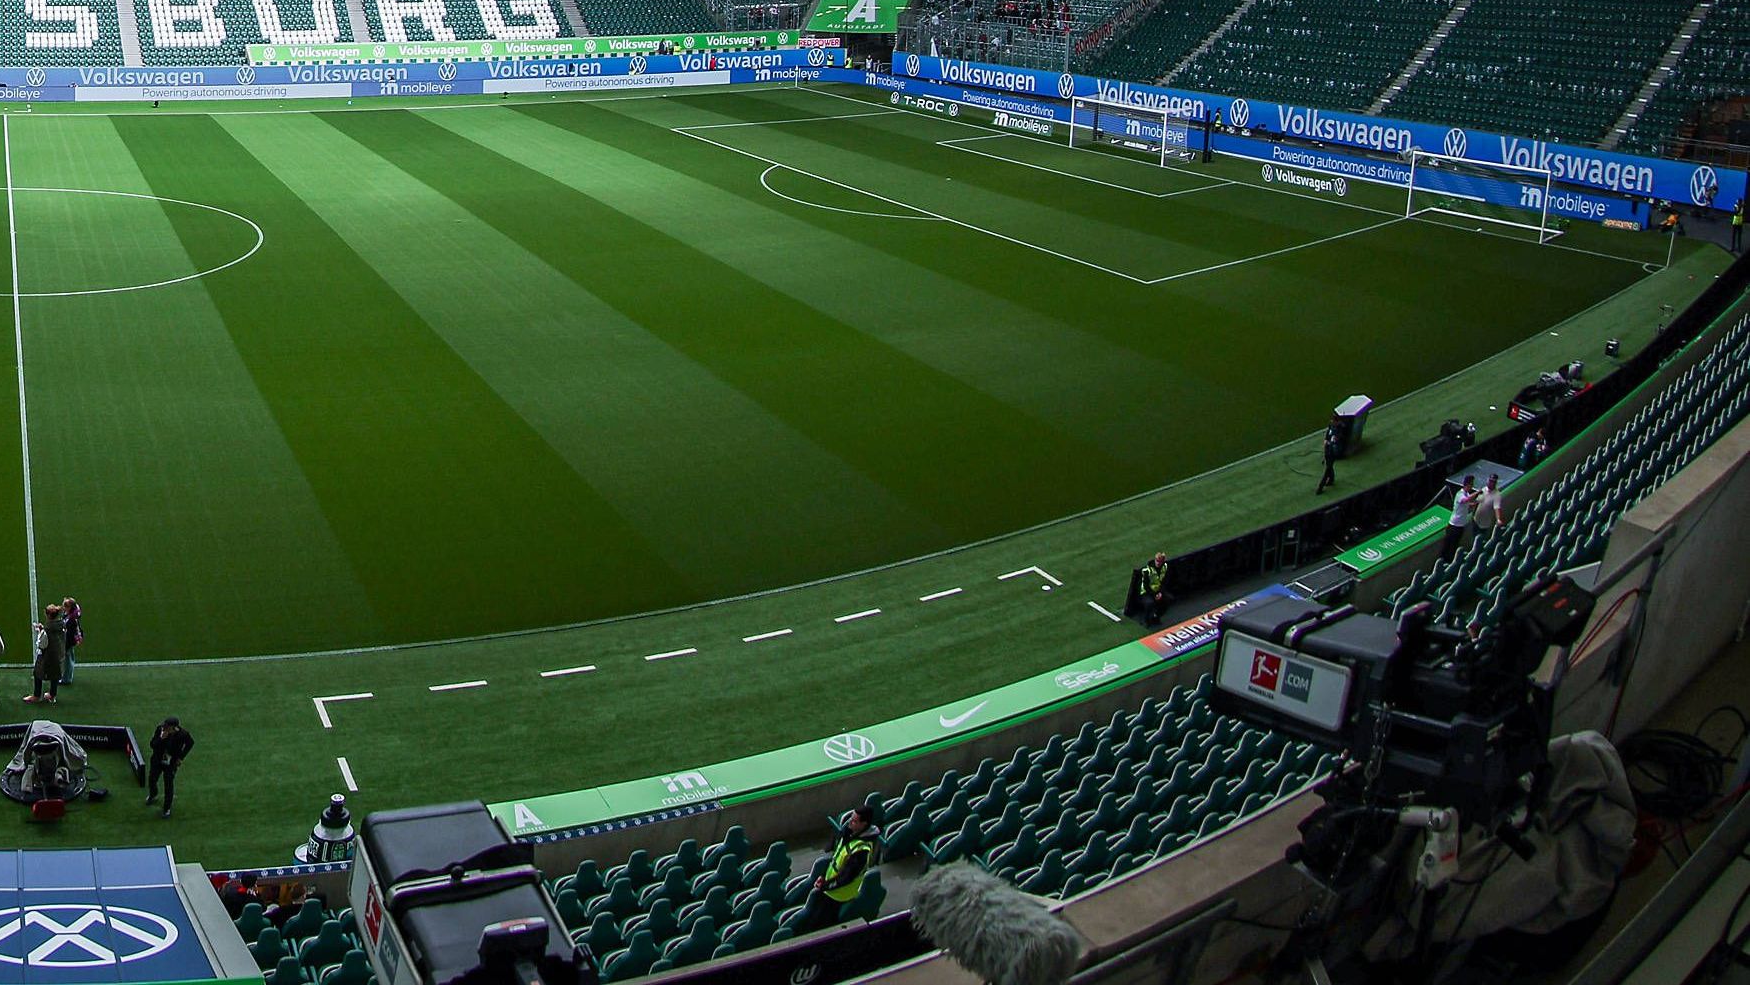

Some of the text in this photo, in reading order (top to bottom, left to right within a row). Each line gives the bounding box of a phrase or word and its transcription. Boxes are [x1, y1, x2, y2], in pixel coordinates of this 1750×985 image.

[826, 23, 885, 31] AUTOSTADT
[505, 40, 573, 55] Volkswagen
[609, 37, 673, 51] Volkswagn
[706, 33, 767, 48] Volkswagn
[813, 38, 840, 47] POWER
[289, 46, 361, 60] Volkswagen
[398, 43, 469, 58] Volkswagen
[79, 66, 204, 88] Volkswagen
[287, 63, 408, 85] Volkswagen
[488, 59, 601, 82] Volkswagen
[772, 68, 821, 82] mobileye
[939, 58, 1036, 92] Volkswagen
[400, 82, 452, 97] mobileye
[545, 72, 675, 92] Powering autonomous driving
[876, 76, 906, 91] mobileye
[142, 85, 287, 101] Powering autonomous driving
[1096, 78, 1204, 120] Volkswagen
[903, 96, 945, 113] T-ROC
[962, 90, 1054, 118] Powering autonomous driving
[1009, 116, 1050, 135] mobileye
[1278, 104, 1412, 151] Volkswagen
[1272, 145, 1412, 183] Powering autonomous driving
[1500, 135, 1653, 193] Volkswagen
[1275, 168, 1333, 192] Volkswagen
[1547, 192, 1607, 217] mobileye
[1395, 515, 1442, 544] WOLFSBURG
[1157, 623, 1206, 647] Mein
[1174, 640, 1195, 652] Kann
[1284, 673, 1310, 691] .COM
[661, 784, 728, 807] mobileye
